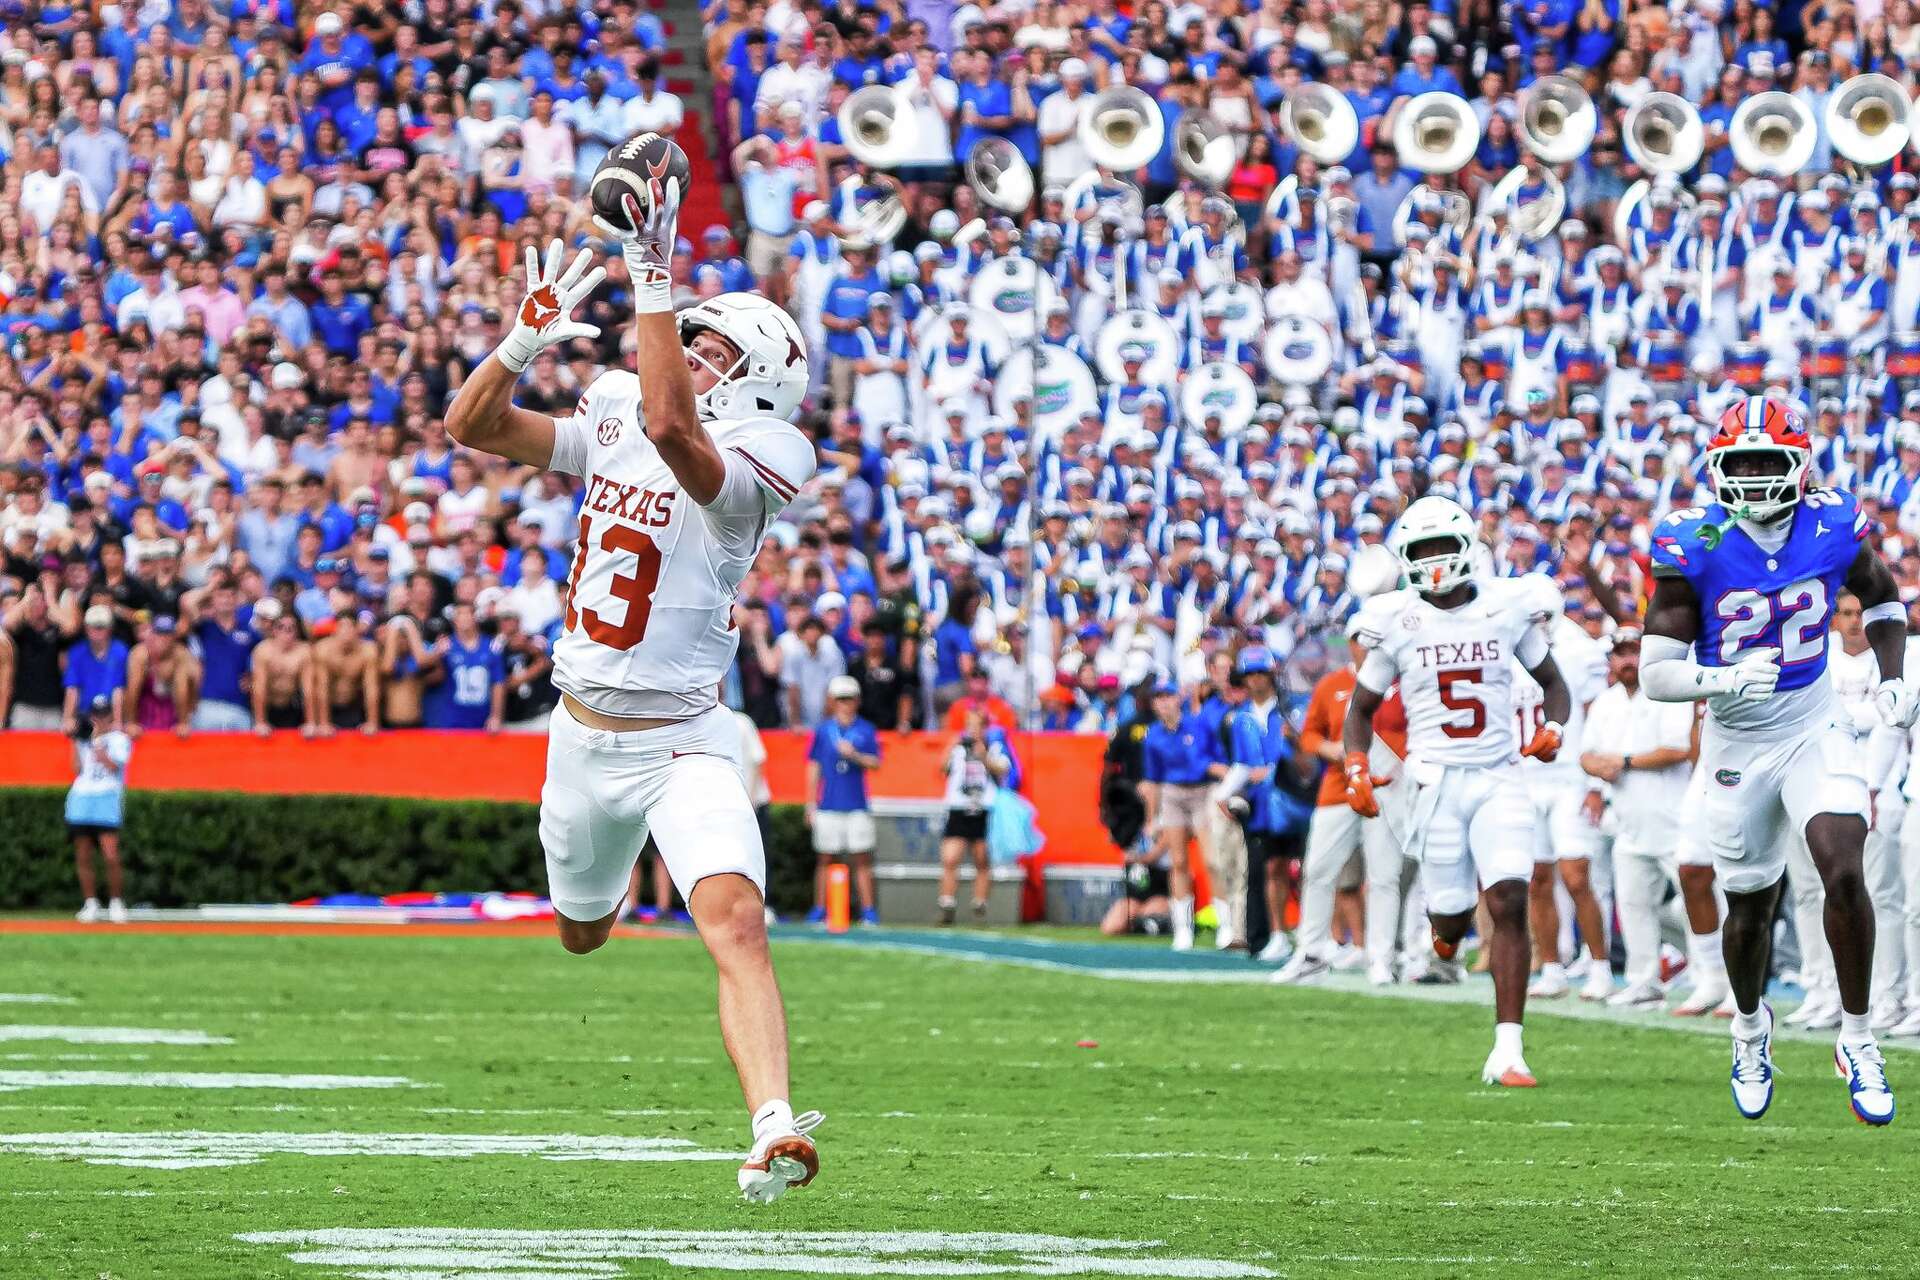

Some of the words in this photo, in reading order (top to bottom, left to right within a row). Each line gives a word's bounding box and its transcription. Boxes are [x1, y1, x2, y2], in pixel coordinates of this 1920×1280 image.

[584, 473, 676, 527] TEXAS
[564, 514, 662, 652] 13
[1416, 640, 1500, 667] TEXAS
[1716, 577, 1830, 668] 22
[1437, 668, 1487, 739] 5
